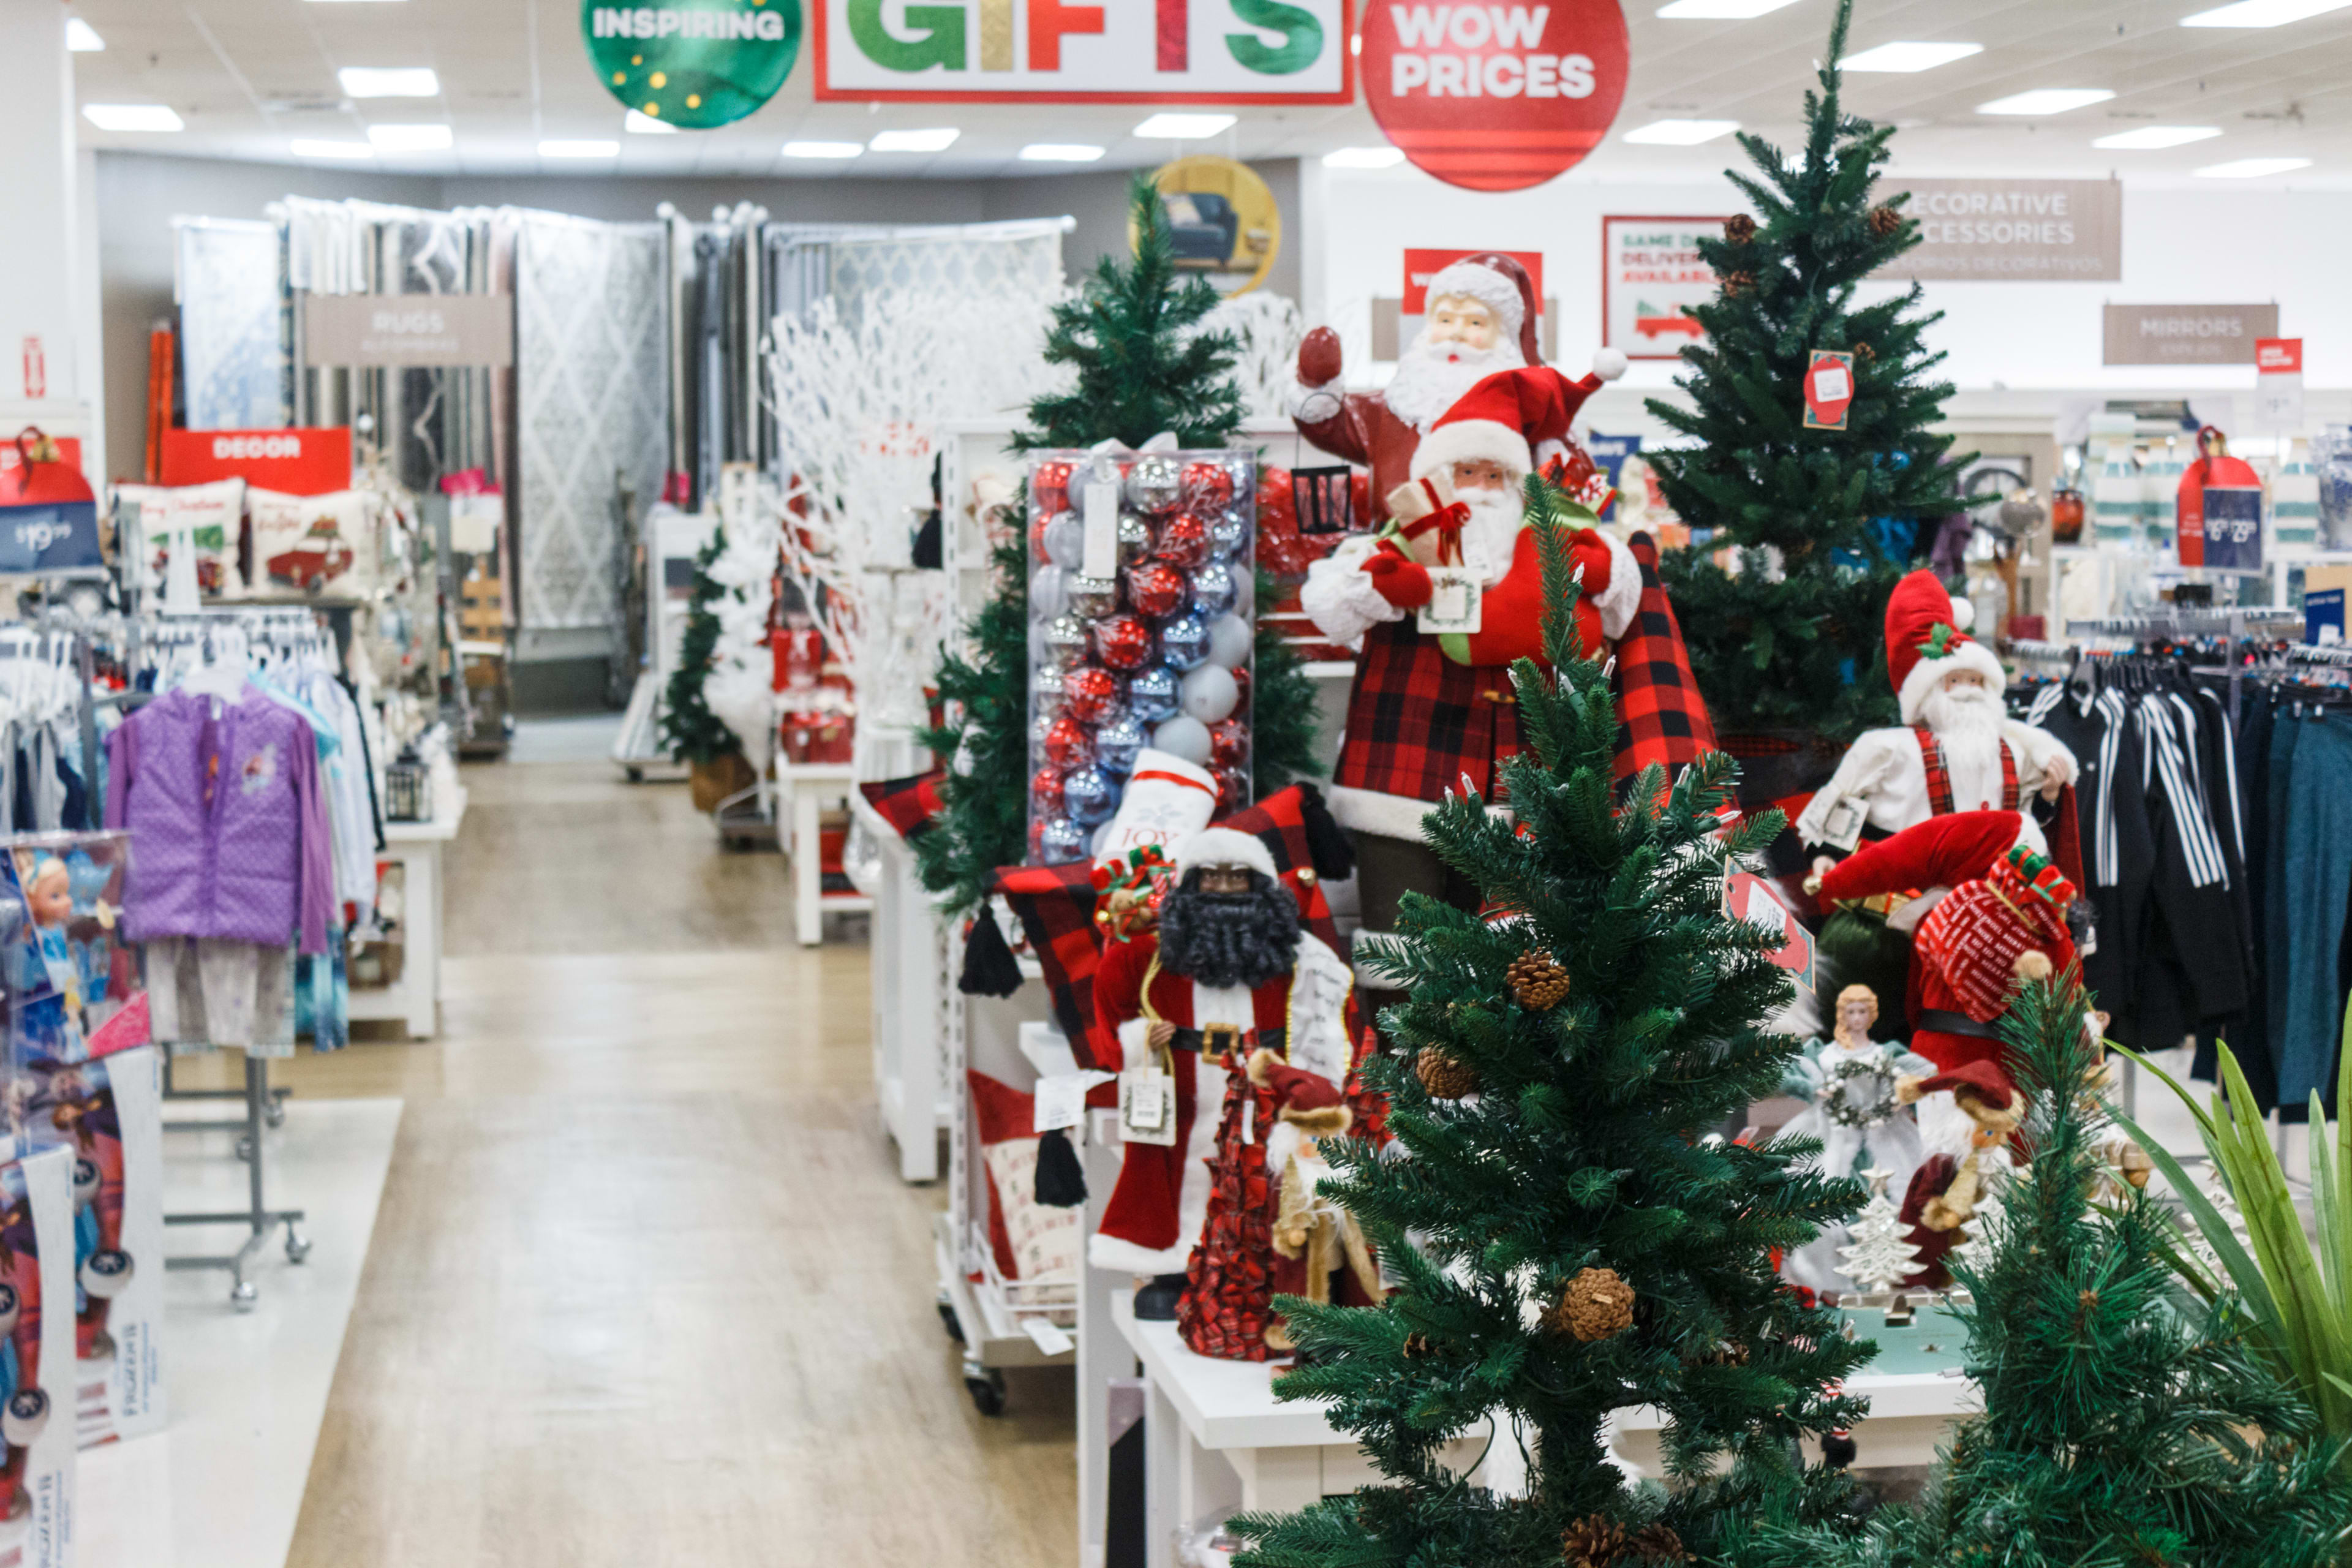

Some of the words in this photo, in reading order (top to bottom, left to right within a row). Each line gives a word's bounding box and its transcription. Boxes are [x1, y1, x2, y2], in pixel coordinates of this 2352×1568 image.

[593, 8, 785, 40] INSPIRING
[1390, 5, 1550, 49] WOW
[1392, 54, 1596, 99] PRICES
[1922, 221, 2075, 244] CESSORIES
[372, 311, 445, 334] RUGS
[2140, 318, 2242, 337] MIRRORS
[213, 435, 301, 459] DECOR
[1121, 828, 1180, 848] JOY
